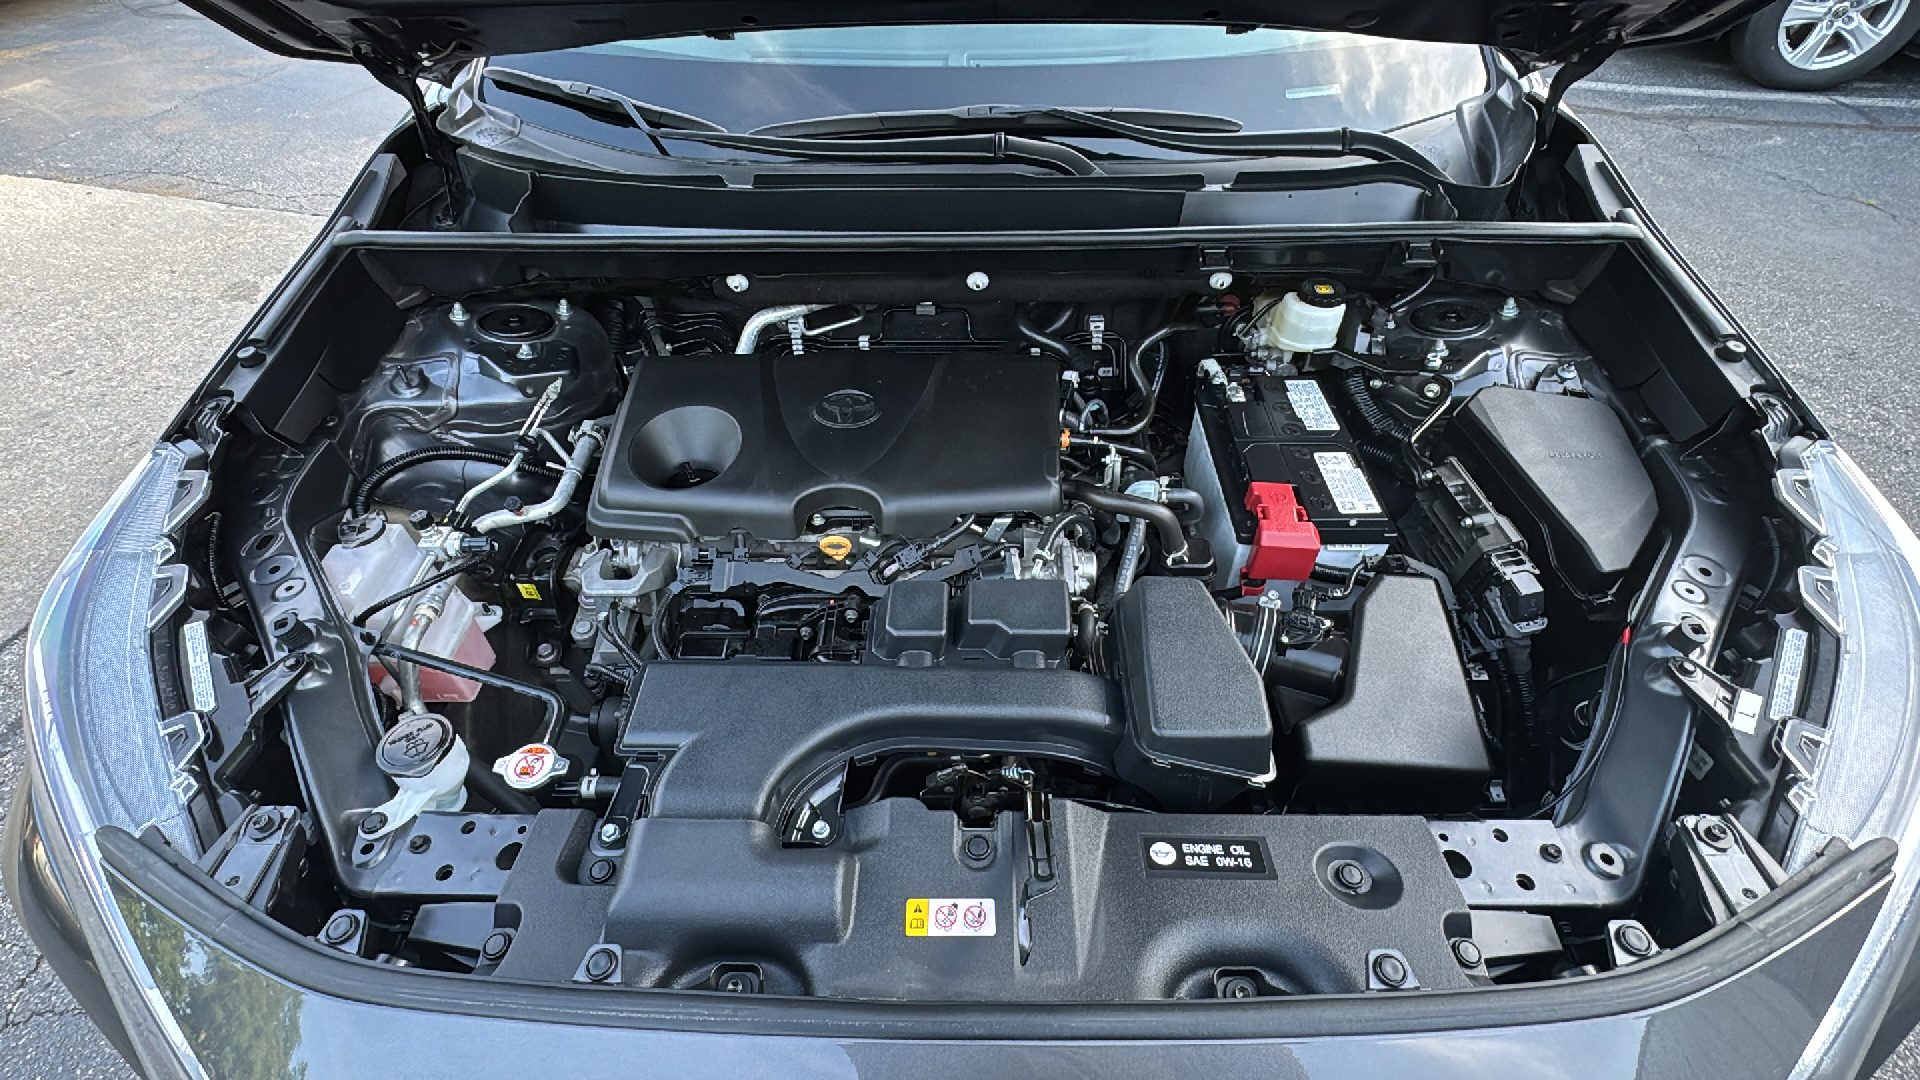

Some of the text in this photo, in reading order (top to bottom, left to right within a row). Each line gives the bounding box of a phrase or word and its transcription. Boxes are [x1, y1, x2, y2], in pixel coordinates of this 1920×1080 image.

[1181, 843, 1251, 856] ENGINE OIL
[1184, 855, 1210, 867] SAE
